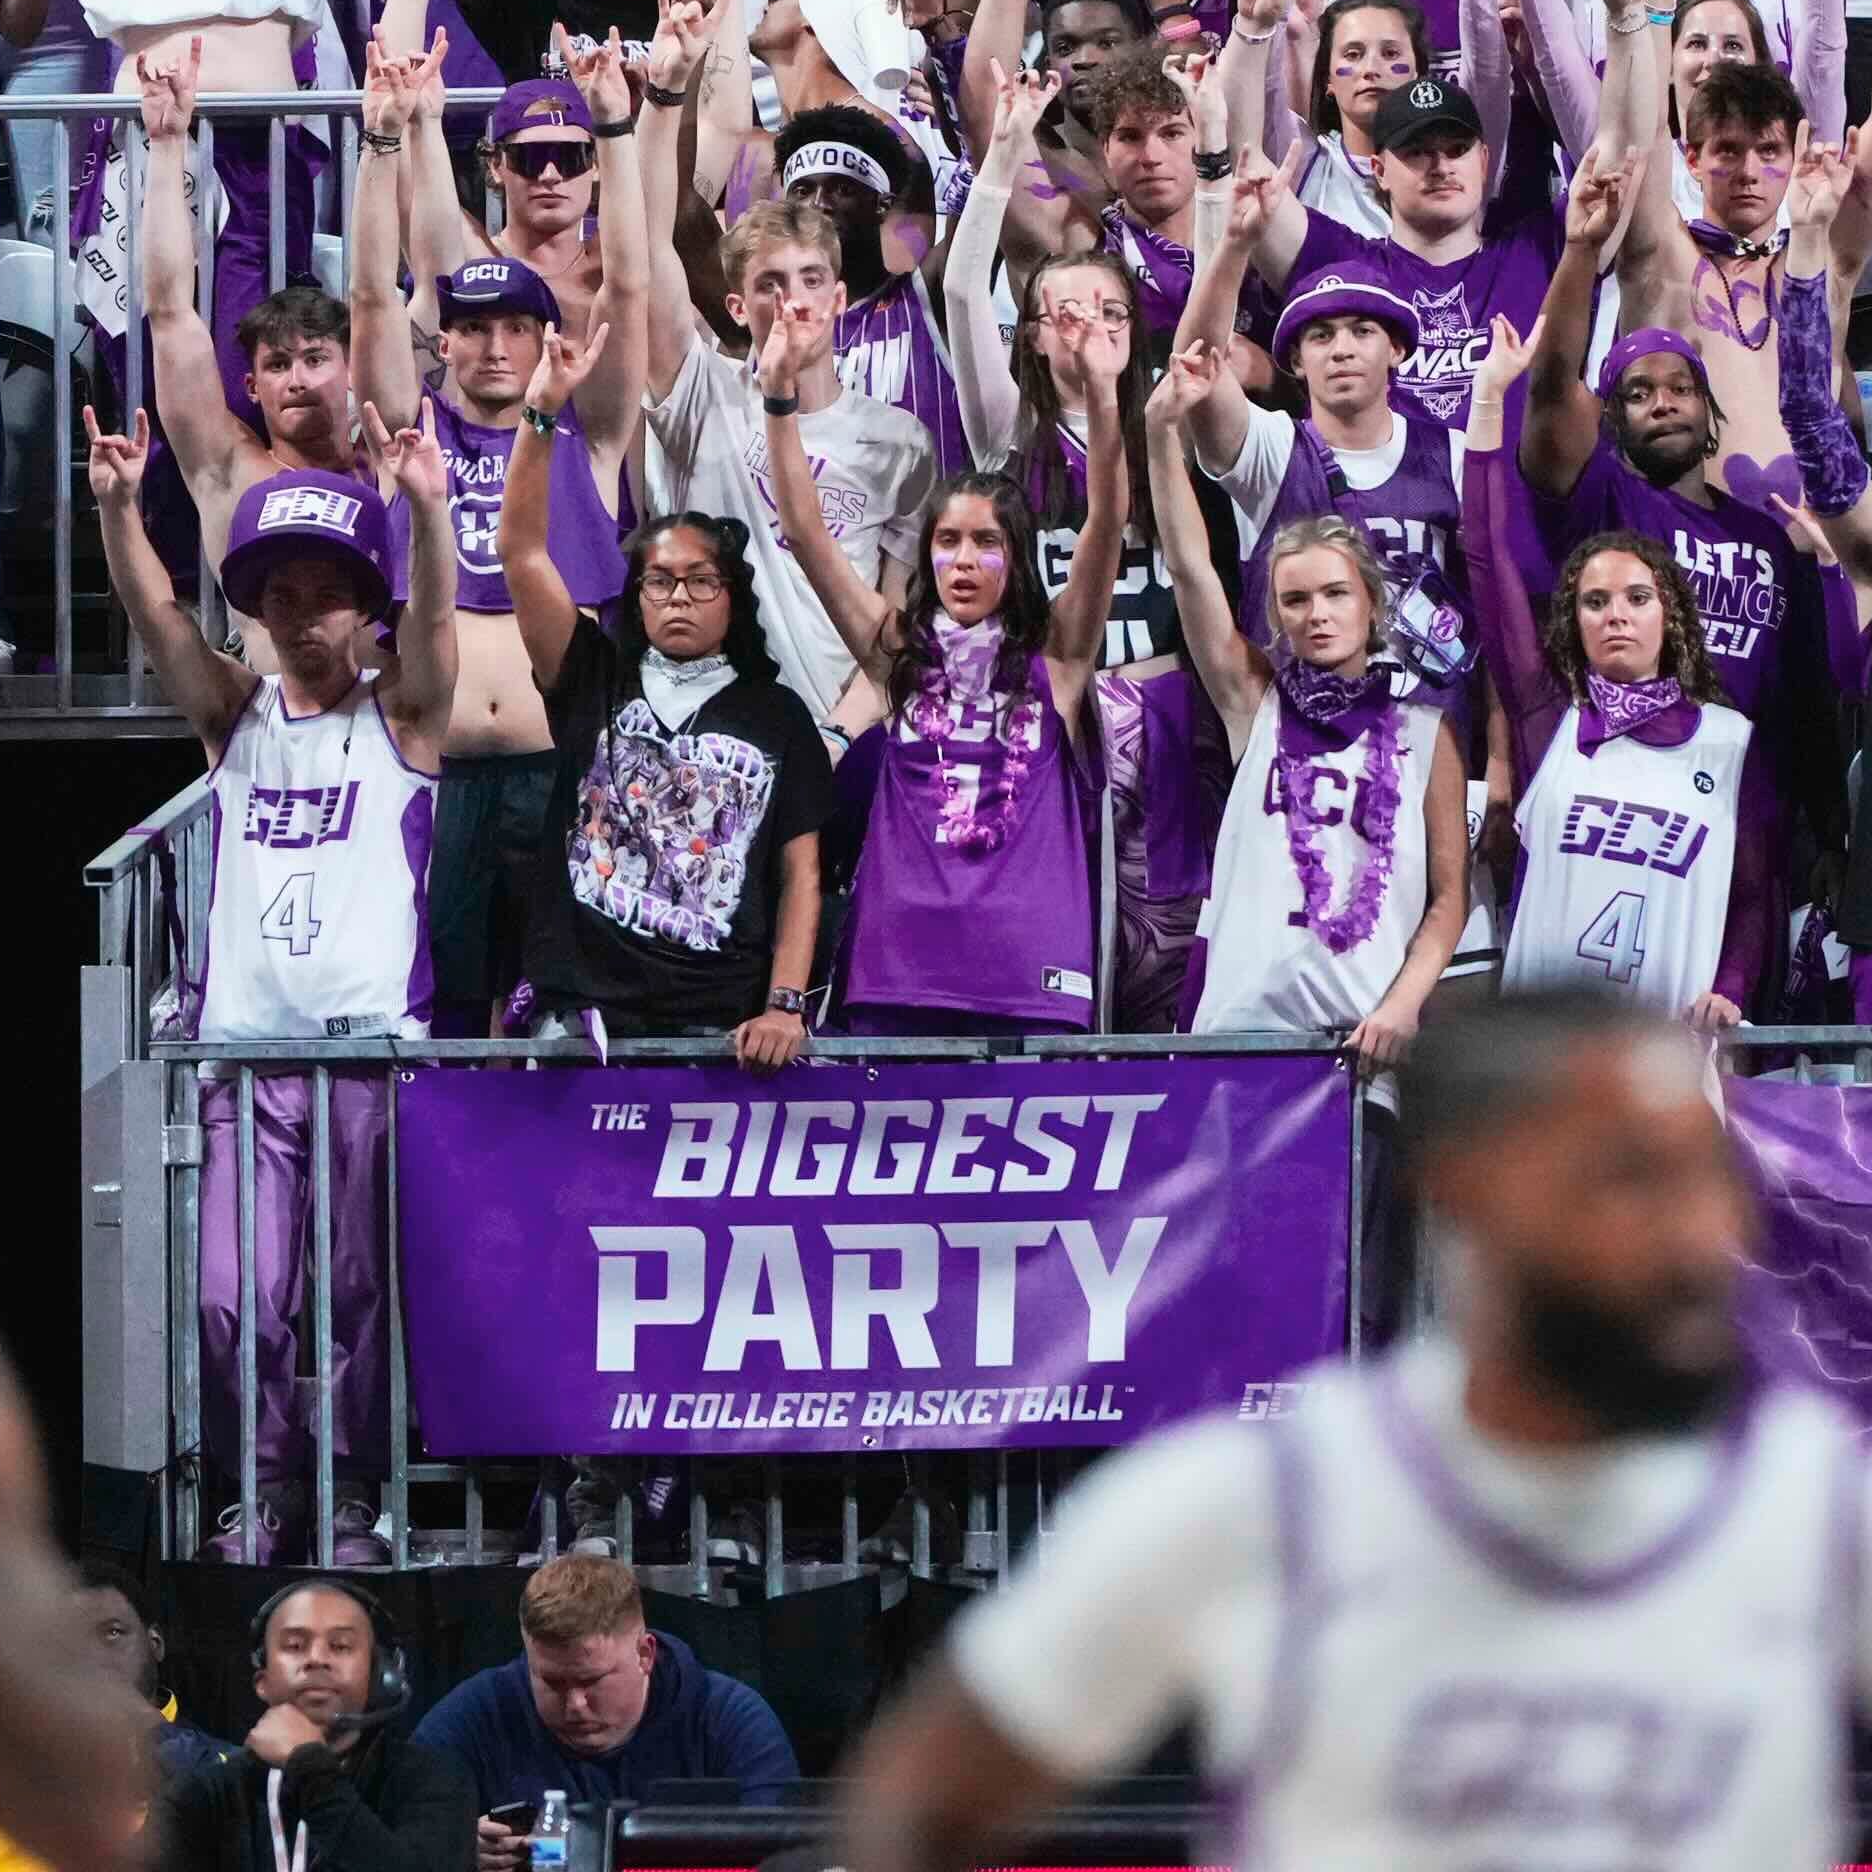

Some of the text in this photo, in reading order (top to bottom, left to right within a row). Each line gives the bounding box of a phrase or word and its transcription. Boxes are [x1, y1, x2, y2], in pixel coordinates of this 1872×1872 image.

[783, 146, 868, 178] HAVOCS
[85, 248, 115, 283] GCU
[460, 265, 508, 283] GCU
[1674, 529, 1776, 580] LET'S
[244, 780, 360, 849] GCU
[1558, 795, 1708, 878] GCU
[260, 871, 322, 957] 4
[1577, 891, 1643, 984] 4
[590, 1093, 1168, 1200] THE BIGGEST
[587, 1215, 1168, 1373] PARTY
[611, 1392, 654, 1431] IN
[661, 1391, 855, 1430] COLLEGE
